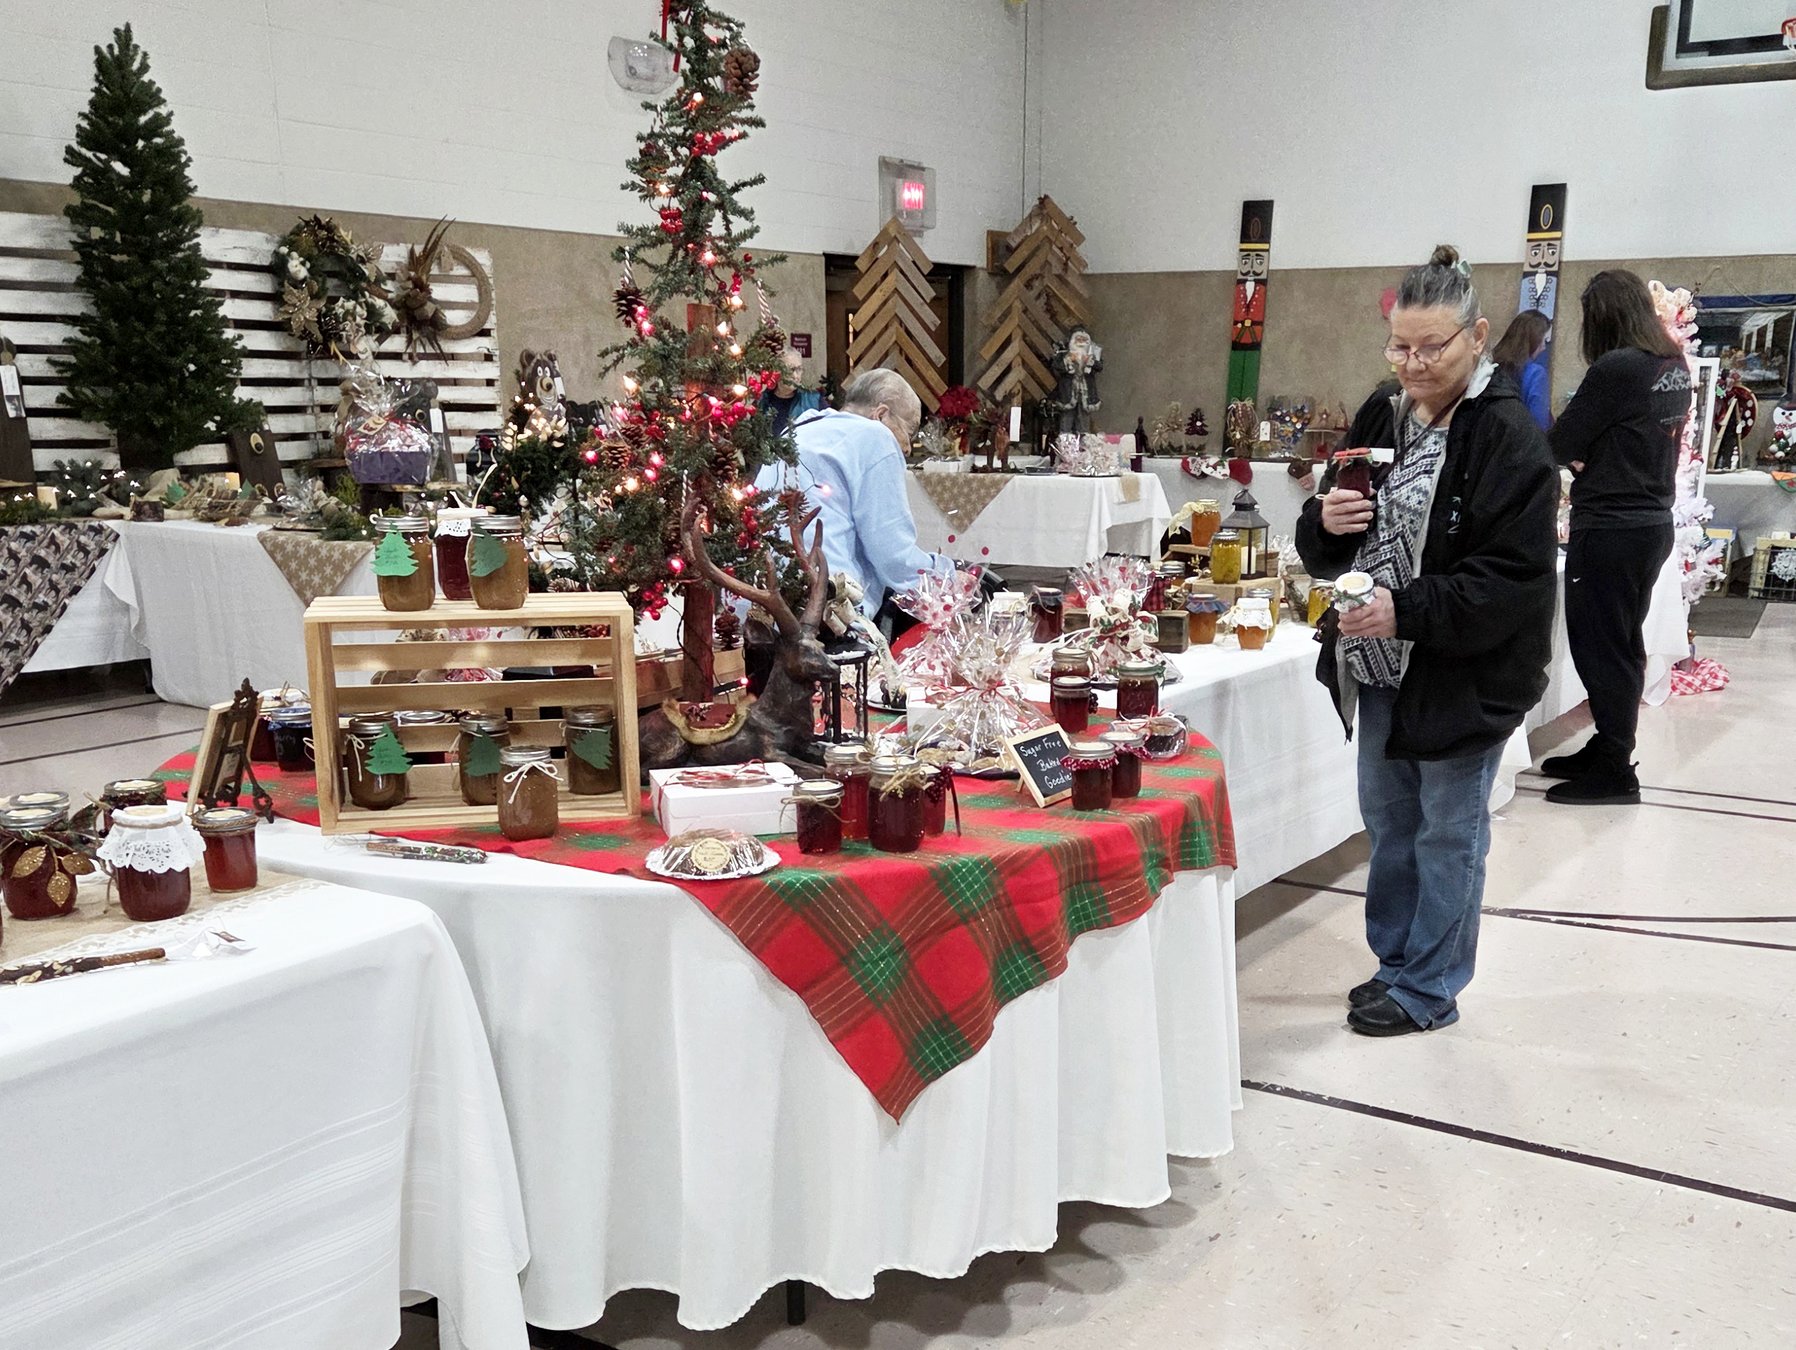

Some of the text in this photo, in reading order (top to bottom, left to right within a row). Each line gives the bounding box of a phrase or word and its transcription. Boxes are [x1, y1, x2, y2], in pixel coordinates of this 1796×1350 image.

[1019, 737, 1062, 758] Sugar Free
[1036, 757, 1061, 771] Baked
